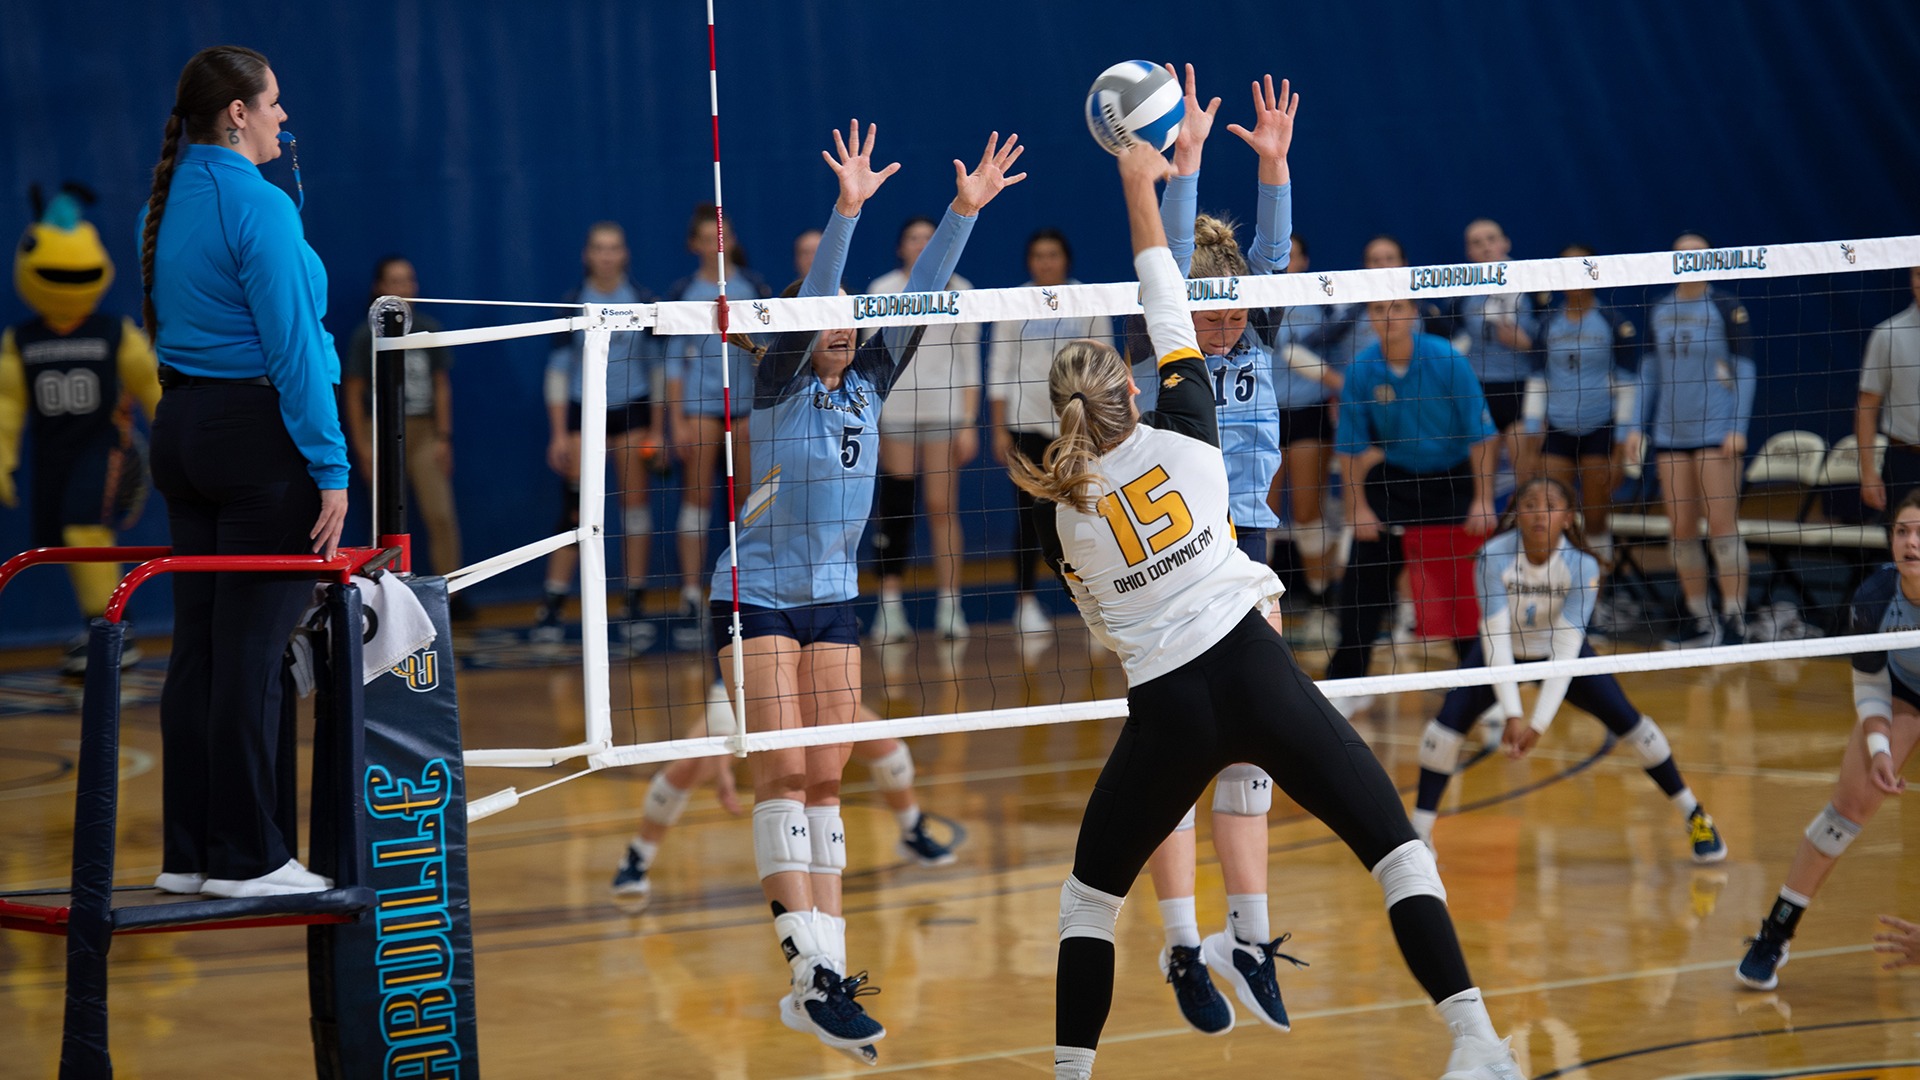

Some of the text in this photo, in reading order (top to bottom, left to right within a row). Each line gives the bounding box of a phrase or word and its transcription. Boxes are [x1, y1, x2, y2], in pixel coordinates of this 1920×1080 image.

[1410, 263, 1508, 291] CEDARVILLE
[1672, 247, 1767, 275] CEDARVILLE
[608, 308, 634, 317] Senoh
[853, 291, 960, 320] CEDARVILLE
[34, 367, 101, 417] 00
[1211, 359, 1256, 408] 15
[838, 424, 866, 471] 5
[1095, 463, 1195, 568] 15
[1113, 525, 1214, 594] OHIO DOMINICAN
